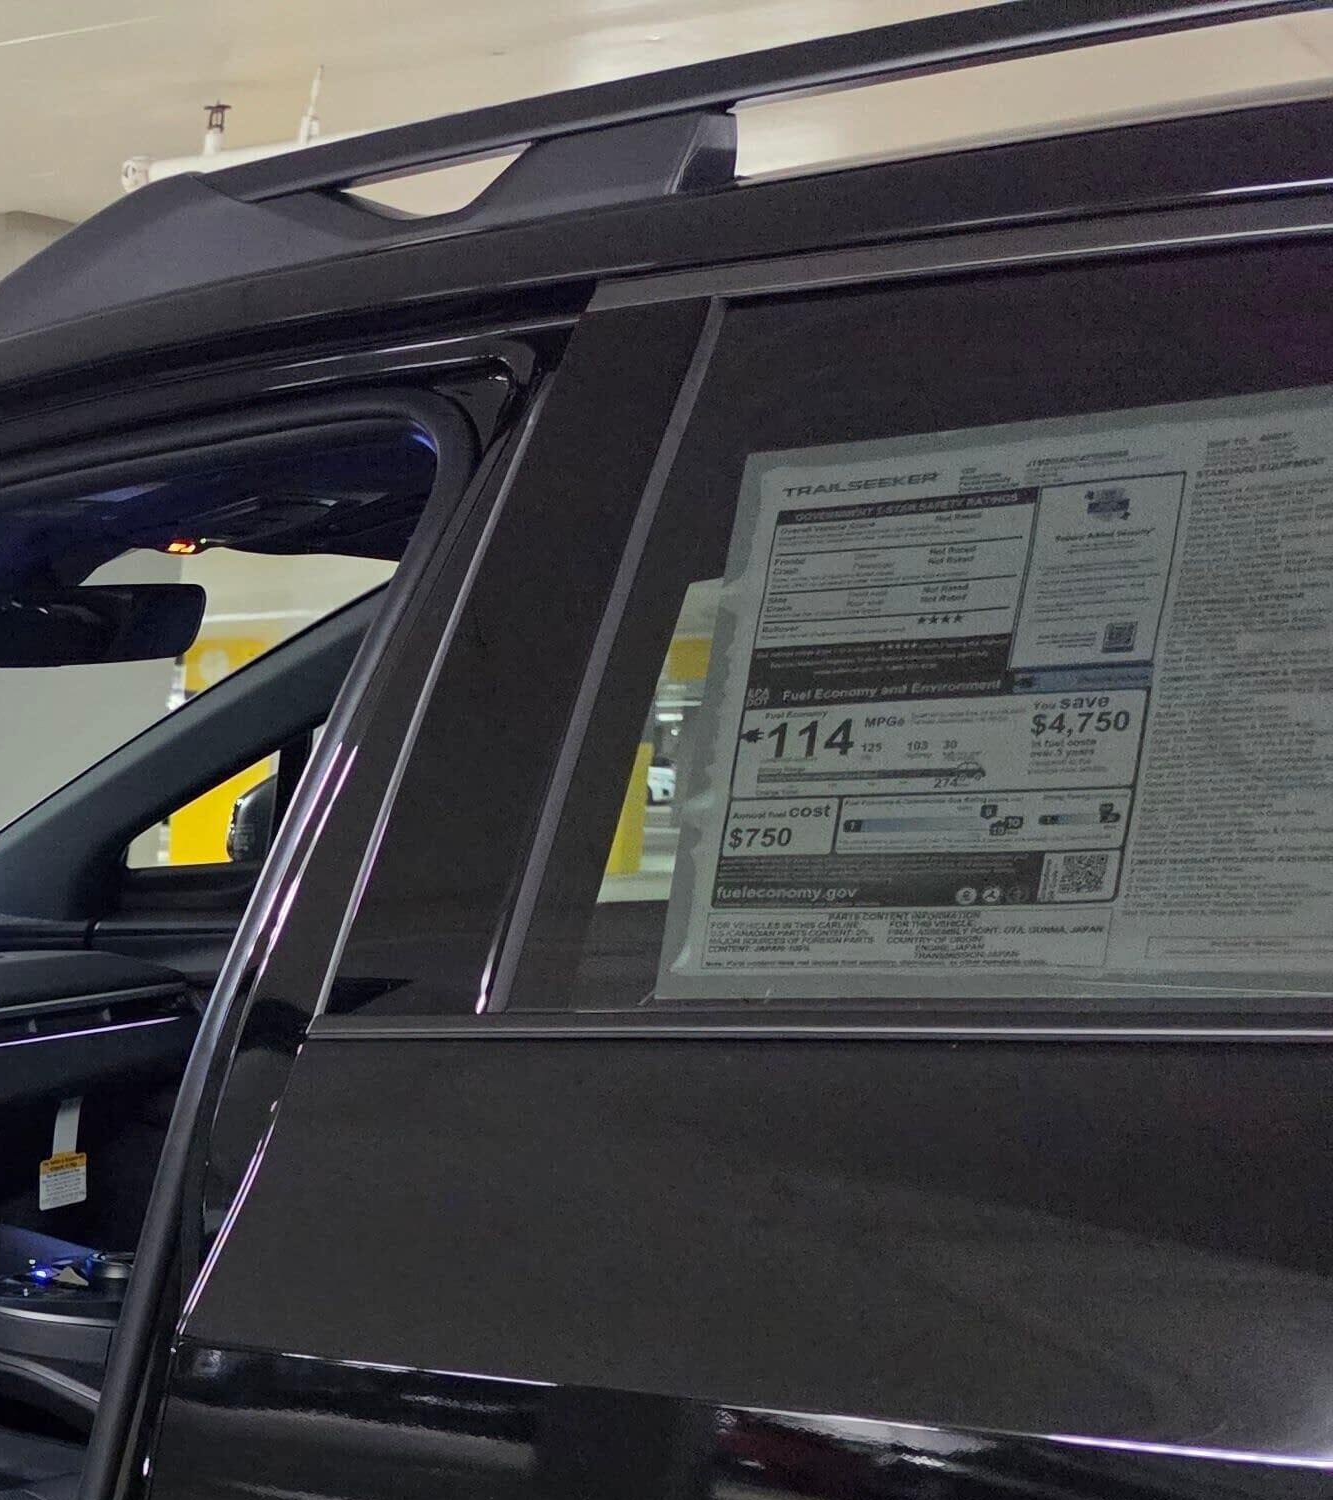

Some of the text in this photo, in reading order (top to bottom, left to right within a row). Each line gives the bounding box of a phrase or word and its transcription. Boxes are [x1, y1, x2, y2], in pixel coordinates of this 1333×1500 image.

[782, 472, 939, 497] TRAILSEEKER
[783, 679, 1002, 702] Fuel Economy and Environment
[1033, 696, 1111, 711] You save
[1030, 709, 1131, 738] $4,750
[767, 717, 855, 759] 114
[942, 739, 959, 750] 30
[861, 742, 883, 753] 125
[933, 777, 959, 789] 274
[788, 803, 832, 819] cost
[728, 826, 793, 851] $750
[716, 885, 858, 902] fueleconomy.gov
